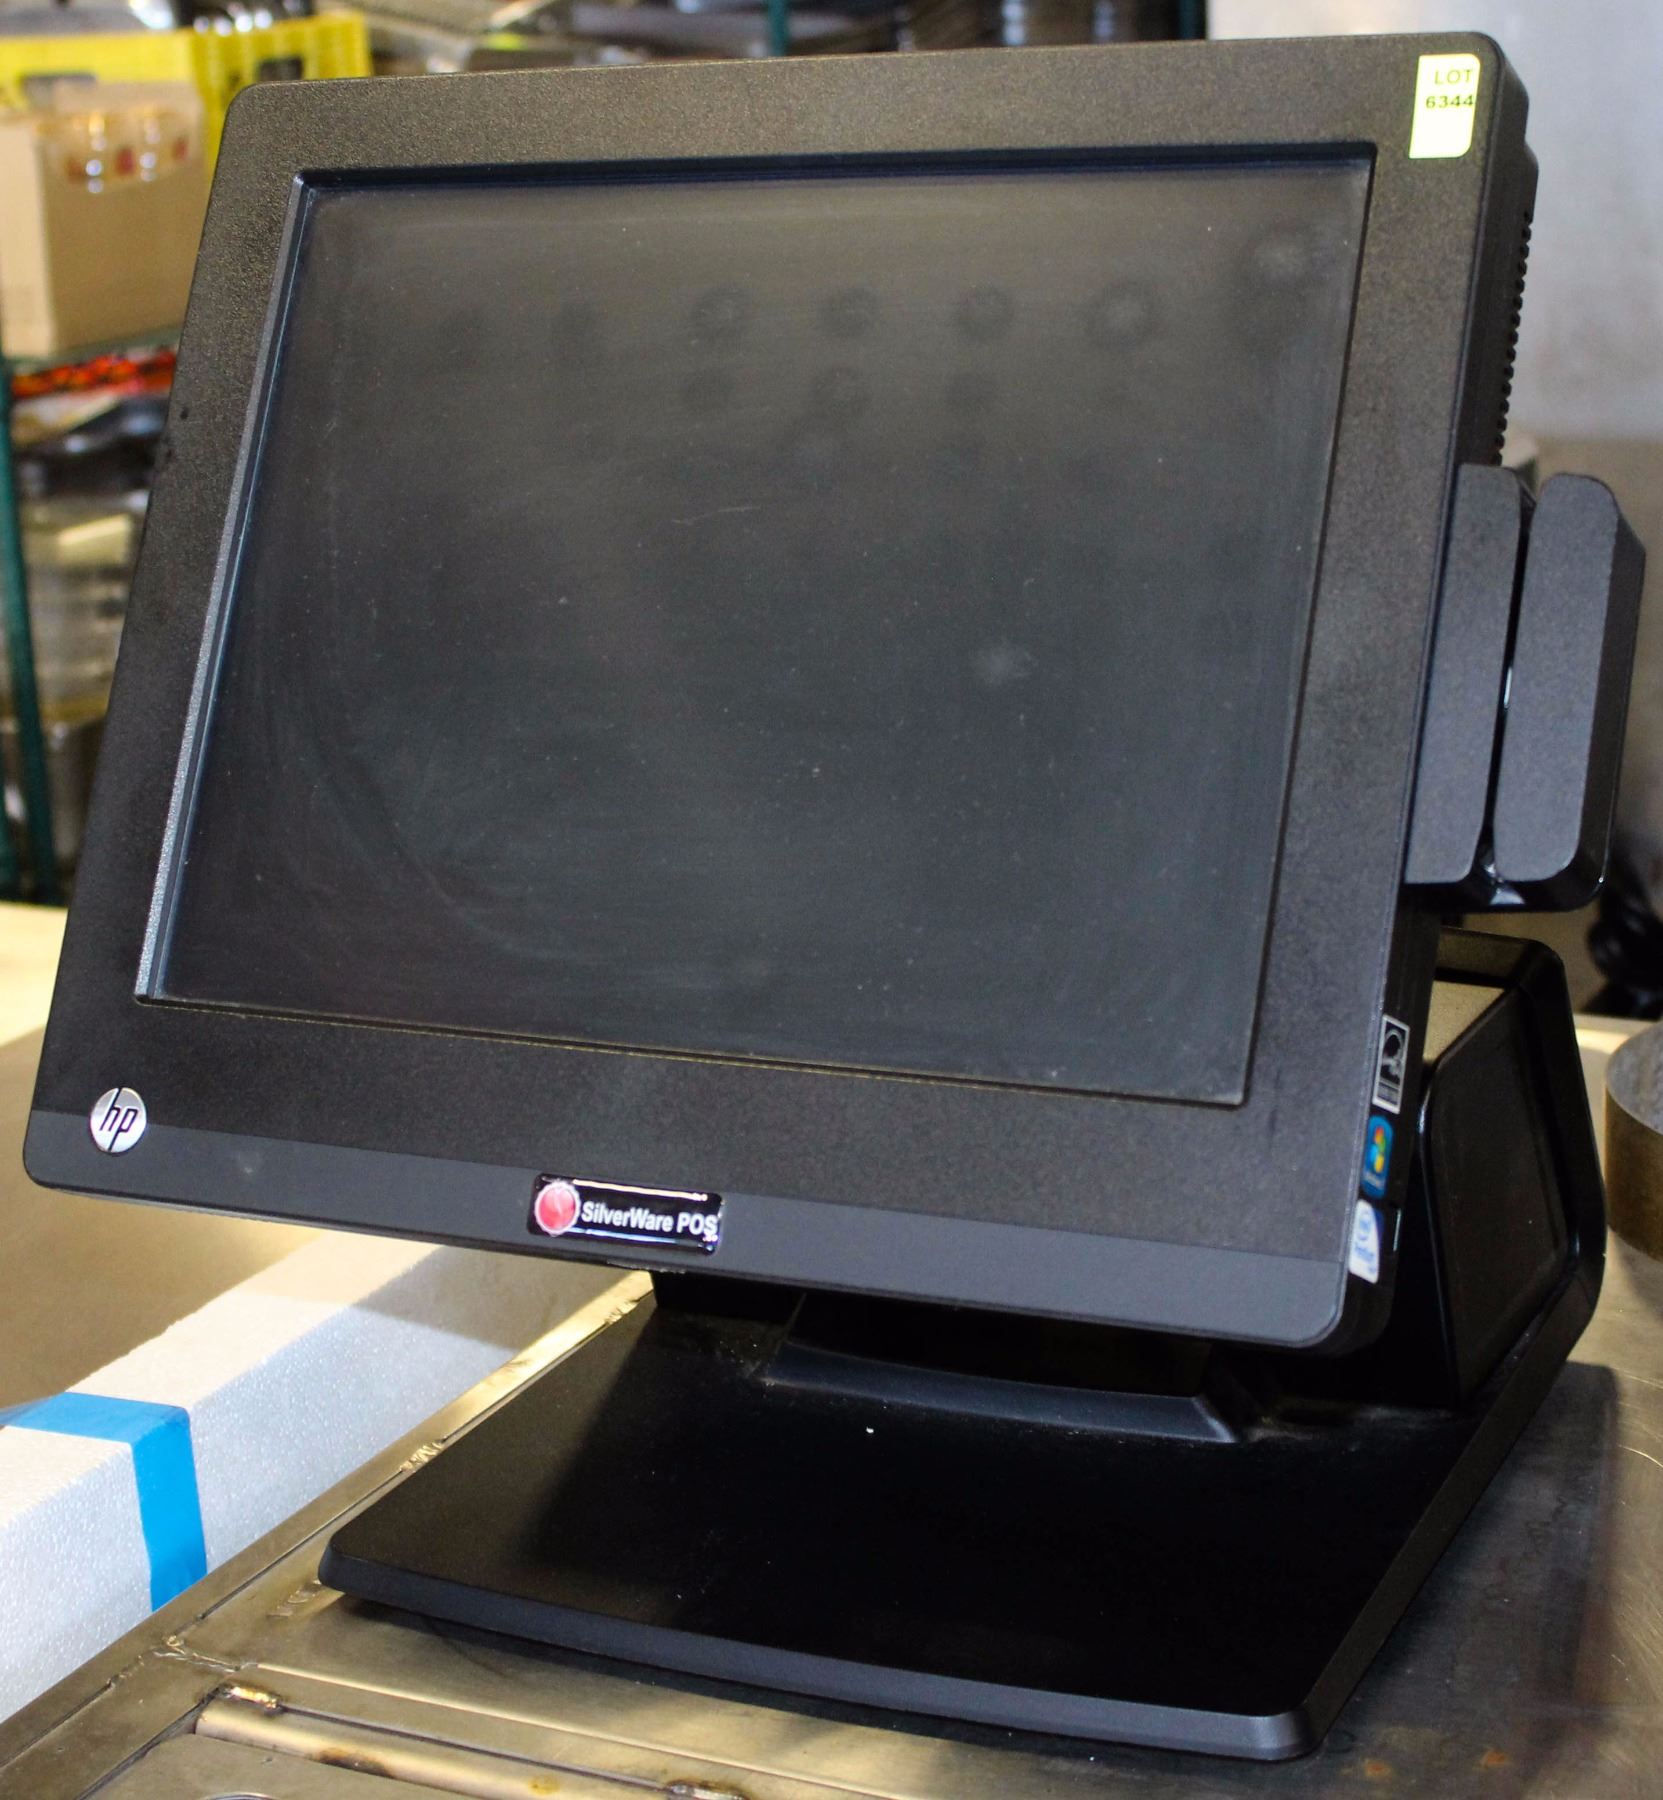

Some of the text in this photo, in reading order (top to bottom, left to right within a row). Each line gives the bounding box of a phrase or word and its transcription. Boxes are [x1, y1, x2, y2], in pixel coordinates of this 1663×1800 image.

[1434, 69, 1473, 85] LOT
[1425, 94, 1474, 109] 6344
[98, 1088, 139, 1153] hp
[580, 1200, 718, 1236] SilverWare POS
